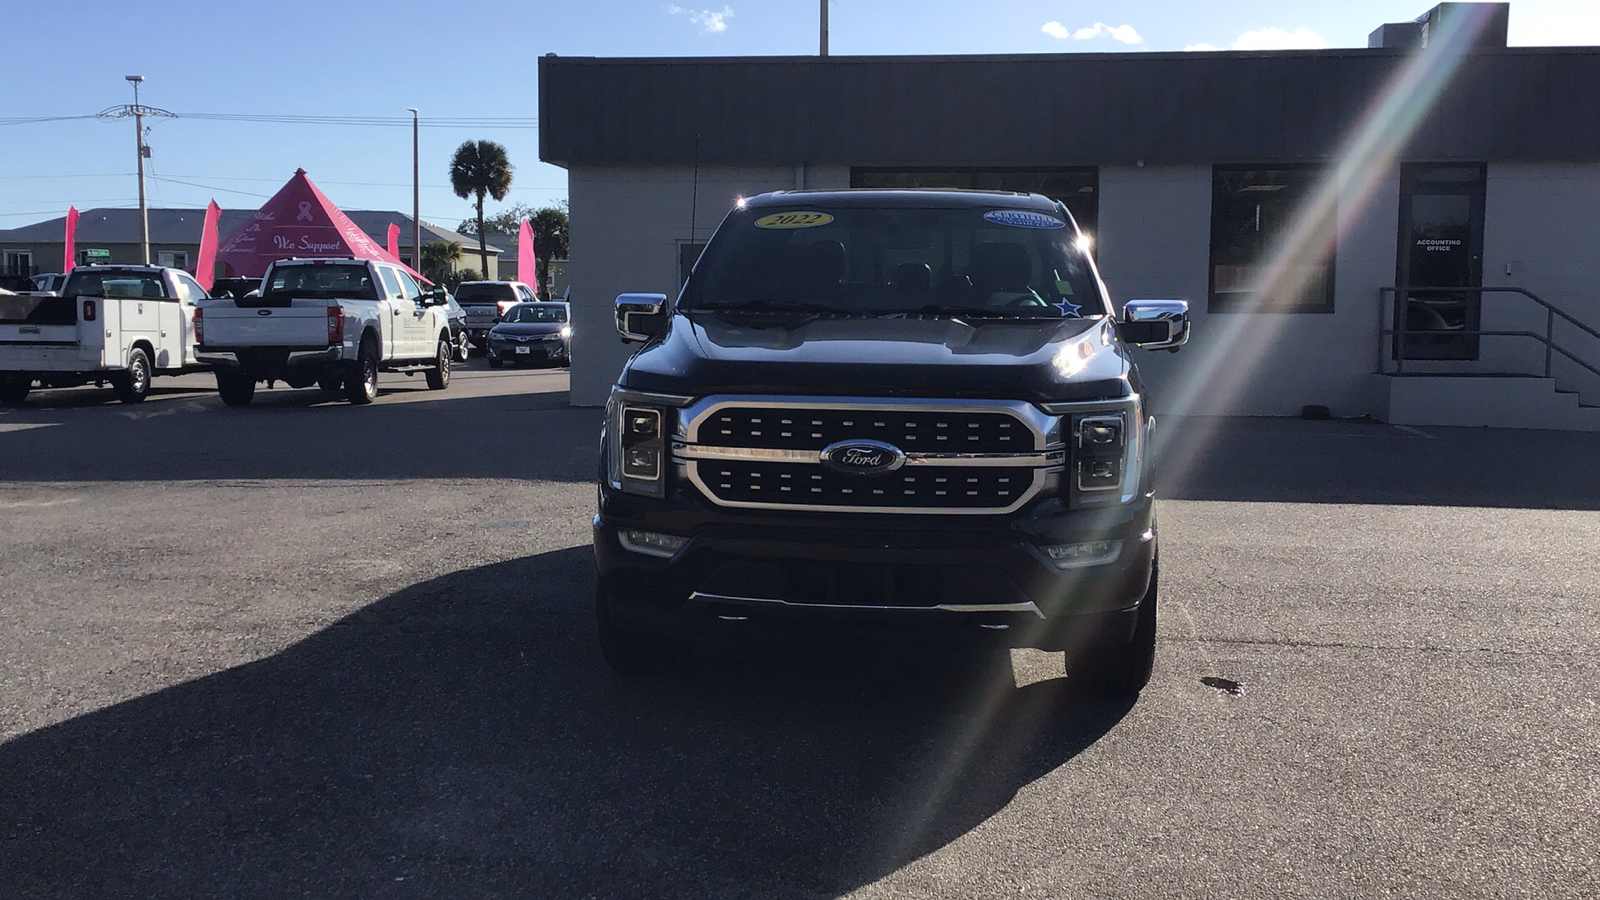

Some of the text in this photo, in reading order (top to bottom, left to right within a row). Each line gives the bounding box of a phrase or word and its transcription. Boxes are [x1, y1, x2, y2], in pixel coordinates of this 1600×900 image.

[765, 214, 822, 226] 2022
[992, 211, 1055, 222] CERTIFIED
[273, 234, 295, 249] We
[298, 235, 340, 253] Support
[842, 448, 883, 466] Ford
